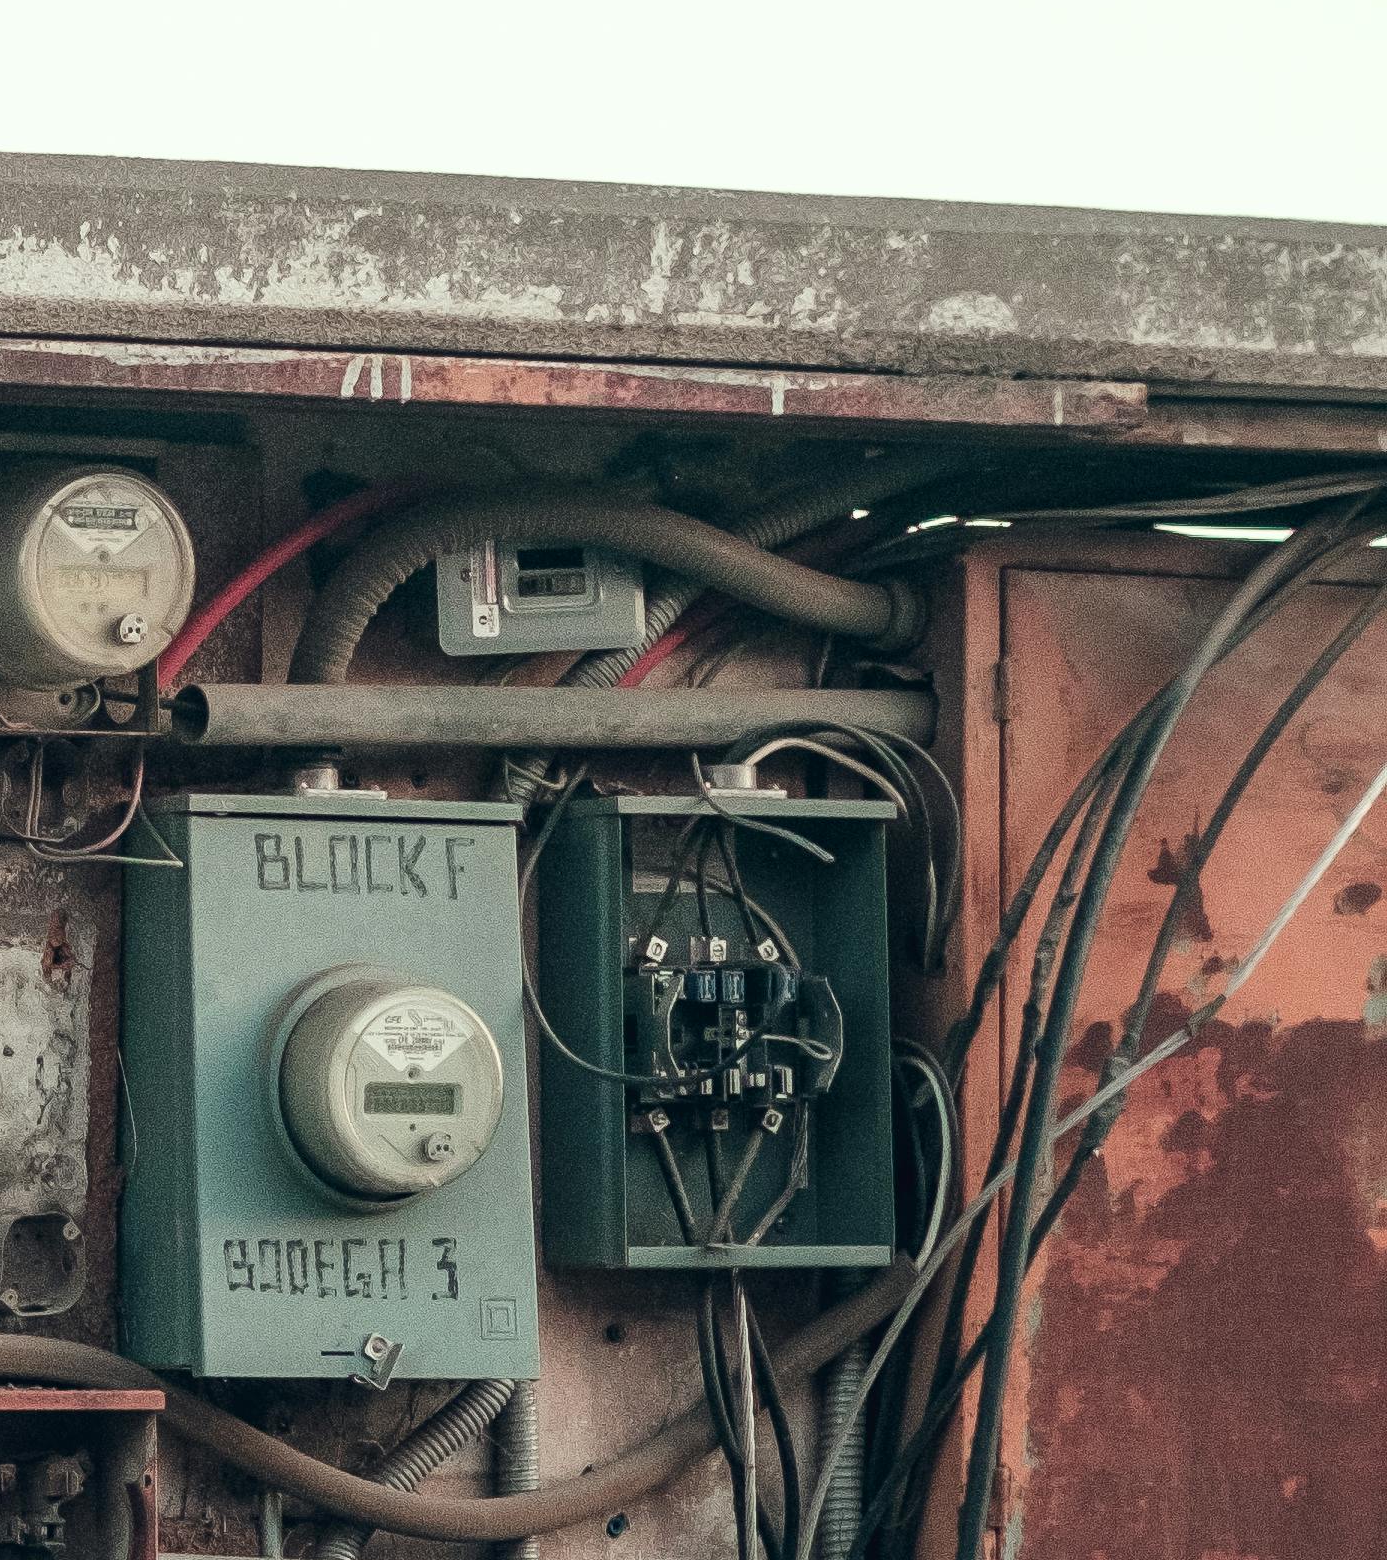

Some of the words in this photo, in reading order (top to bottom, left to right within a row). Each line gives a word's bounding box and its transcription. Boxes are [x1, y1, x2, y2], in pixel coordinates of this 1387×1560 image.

[255, 833, 428, 897] BLOCK
[445, 837, 475, 900] F
[223, 1238, 408, 1300] BODEGA
[431, 1237, 459, 1300] 3
